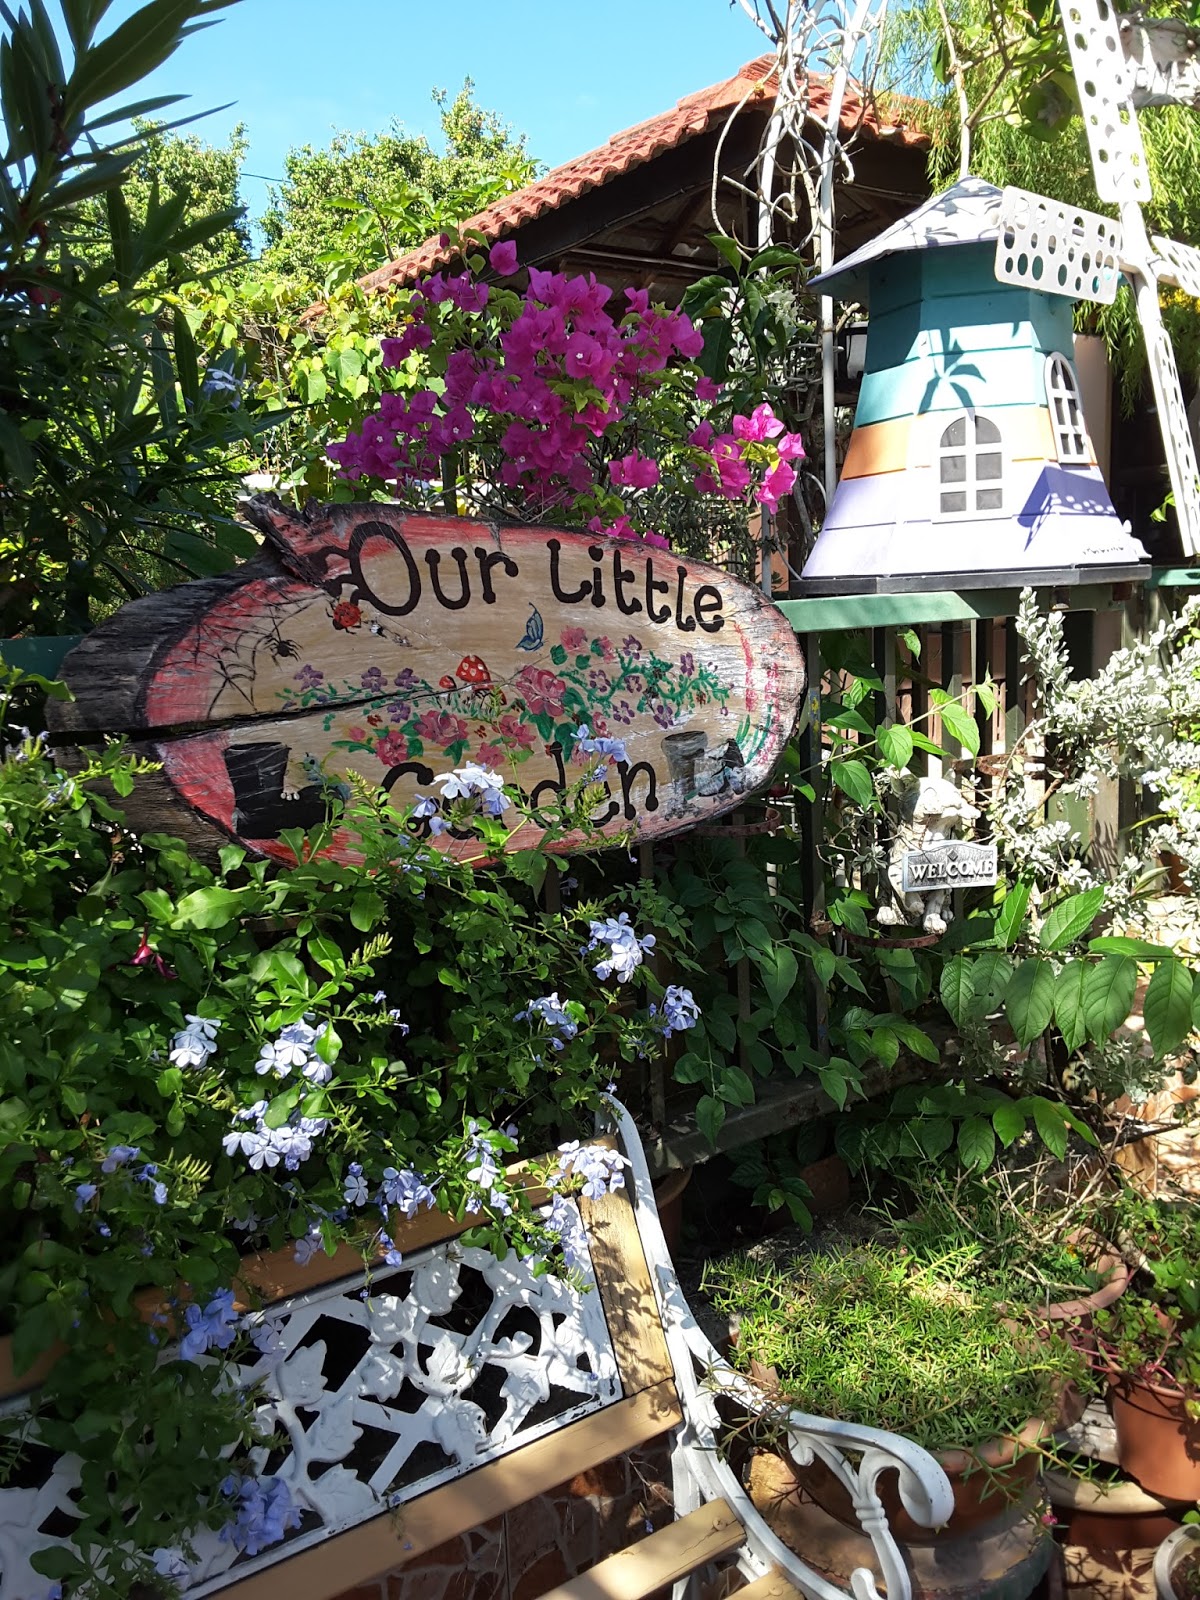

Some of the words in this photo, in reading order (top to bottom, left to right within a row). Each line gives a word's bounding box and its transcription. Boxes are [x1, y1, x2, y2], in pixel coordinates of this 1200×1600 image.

[312, 521, 519, 616] Our
[547, 538, 724, 633] Little
[909, 860, 994, 881] WELCOME
